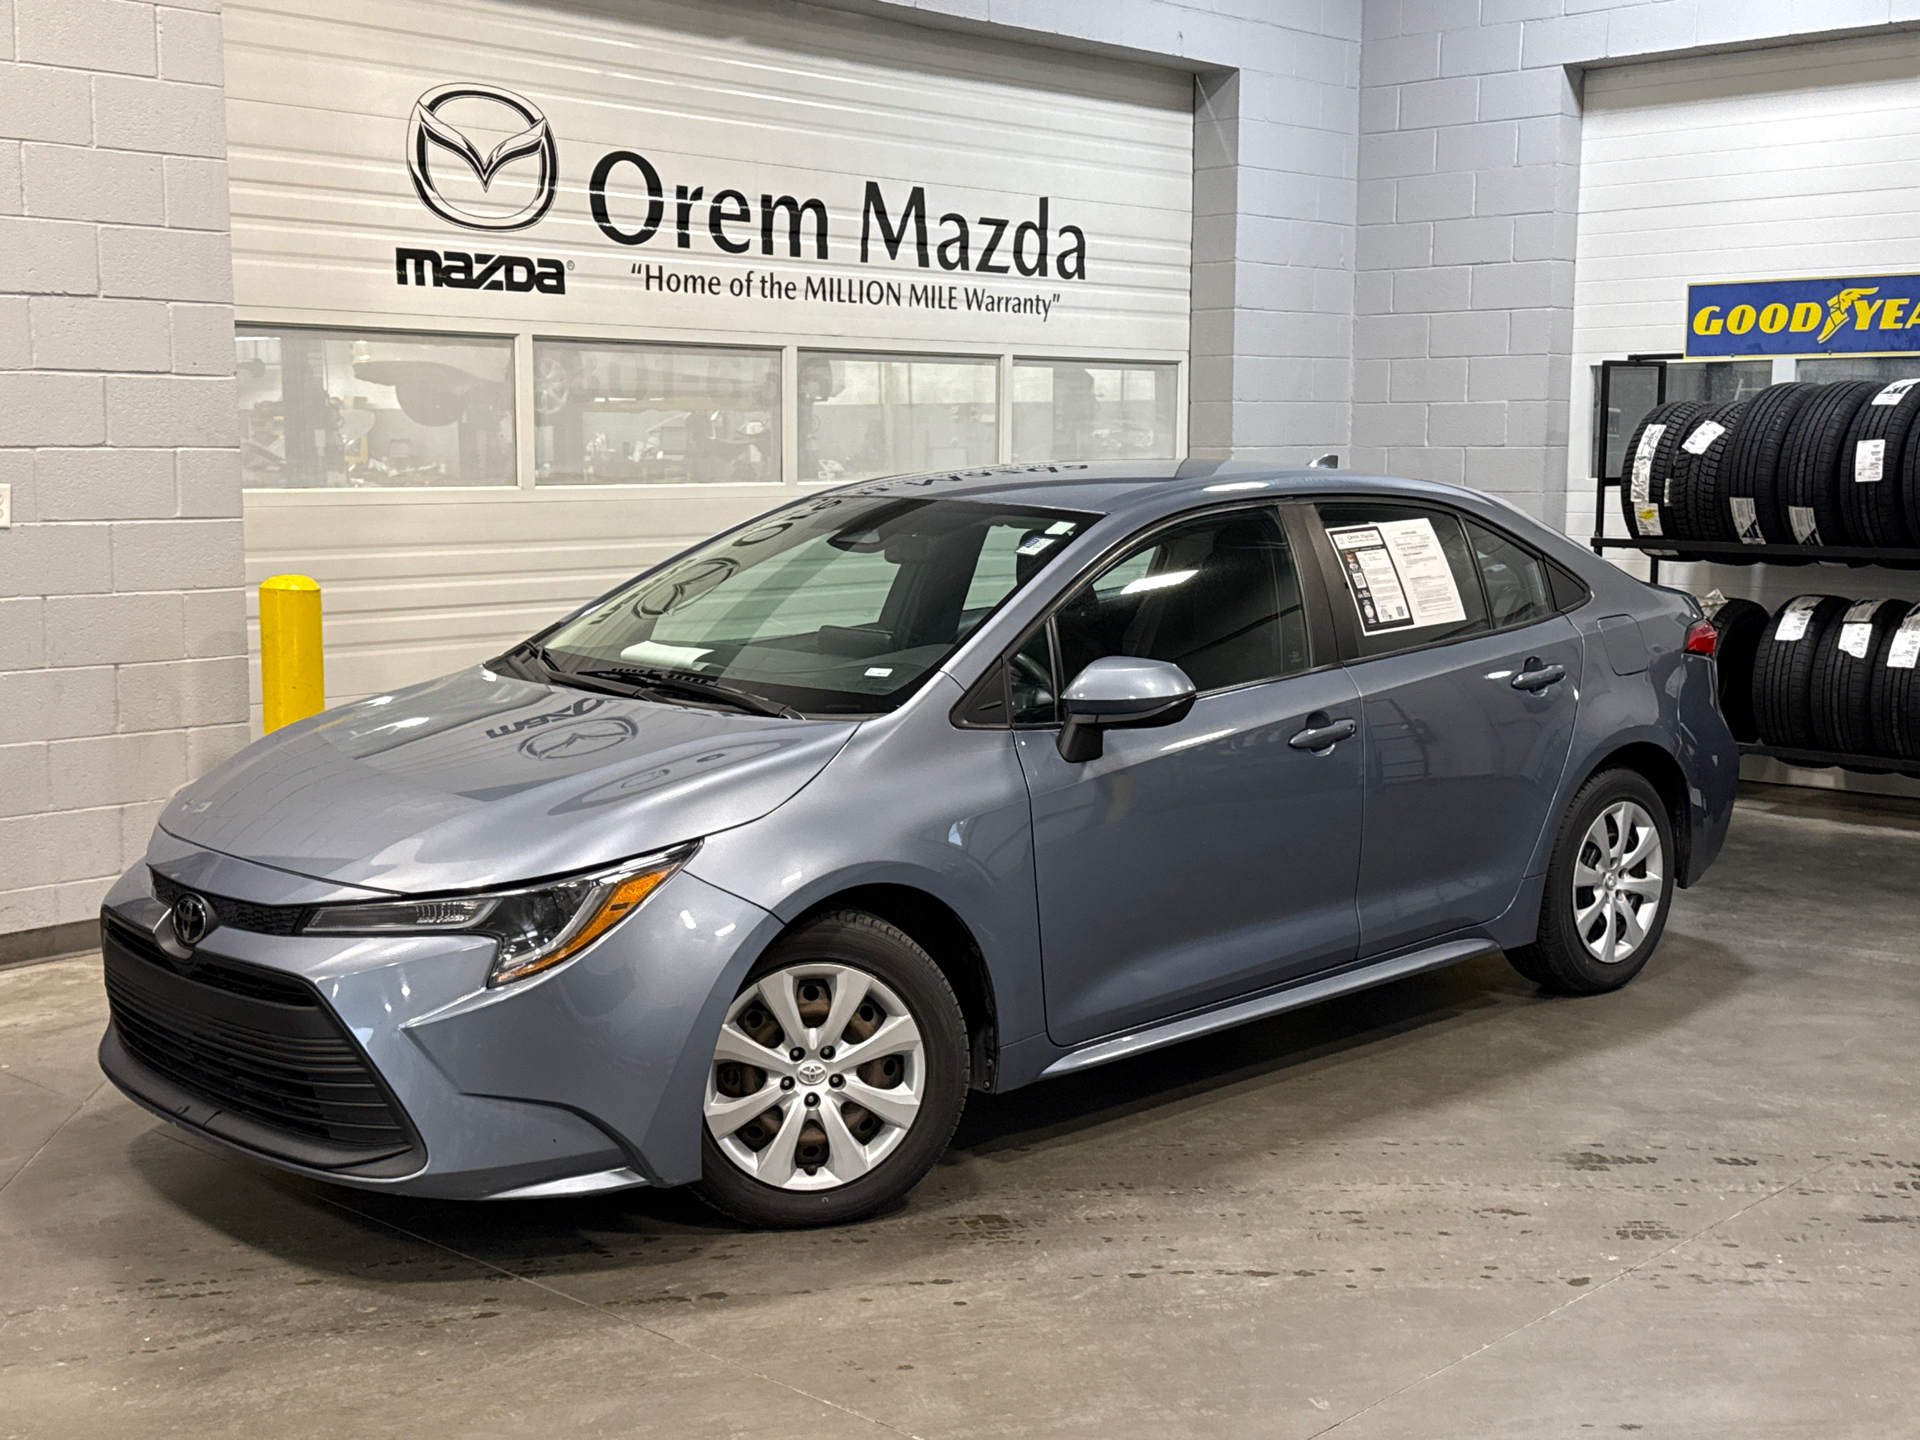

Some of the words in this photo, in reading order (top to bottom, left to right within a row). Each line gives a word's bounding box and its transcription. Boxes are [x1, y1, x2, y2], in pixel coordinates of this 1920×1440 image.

[589, 150, 829, 260] Orem
[860, 180, 1086, 280] Mazda
[729, 270, 755, 298] of
[760, 272, 797, 300] the
[804, 276, 901, 307] MILLION
[909, 283, 958, 310] MILE
